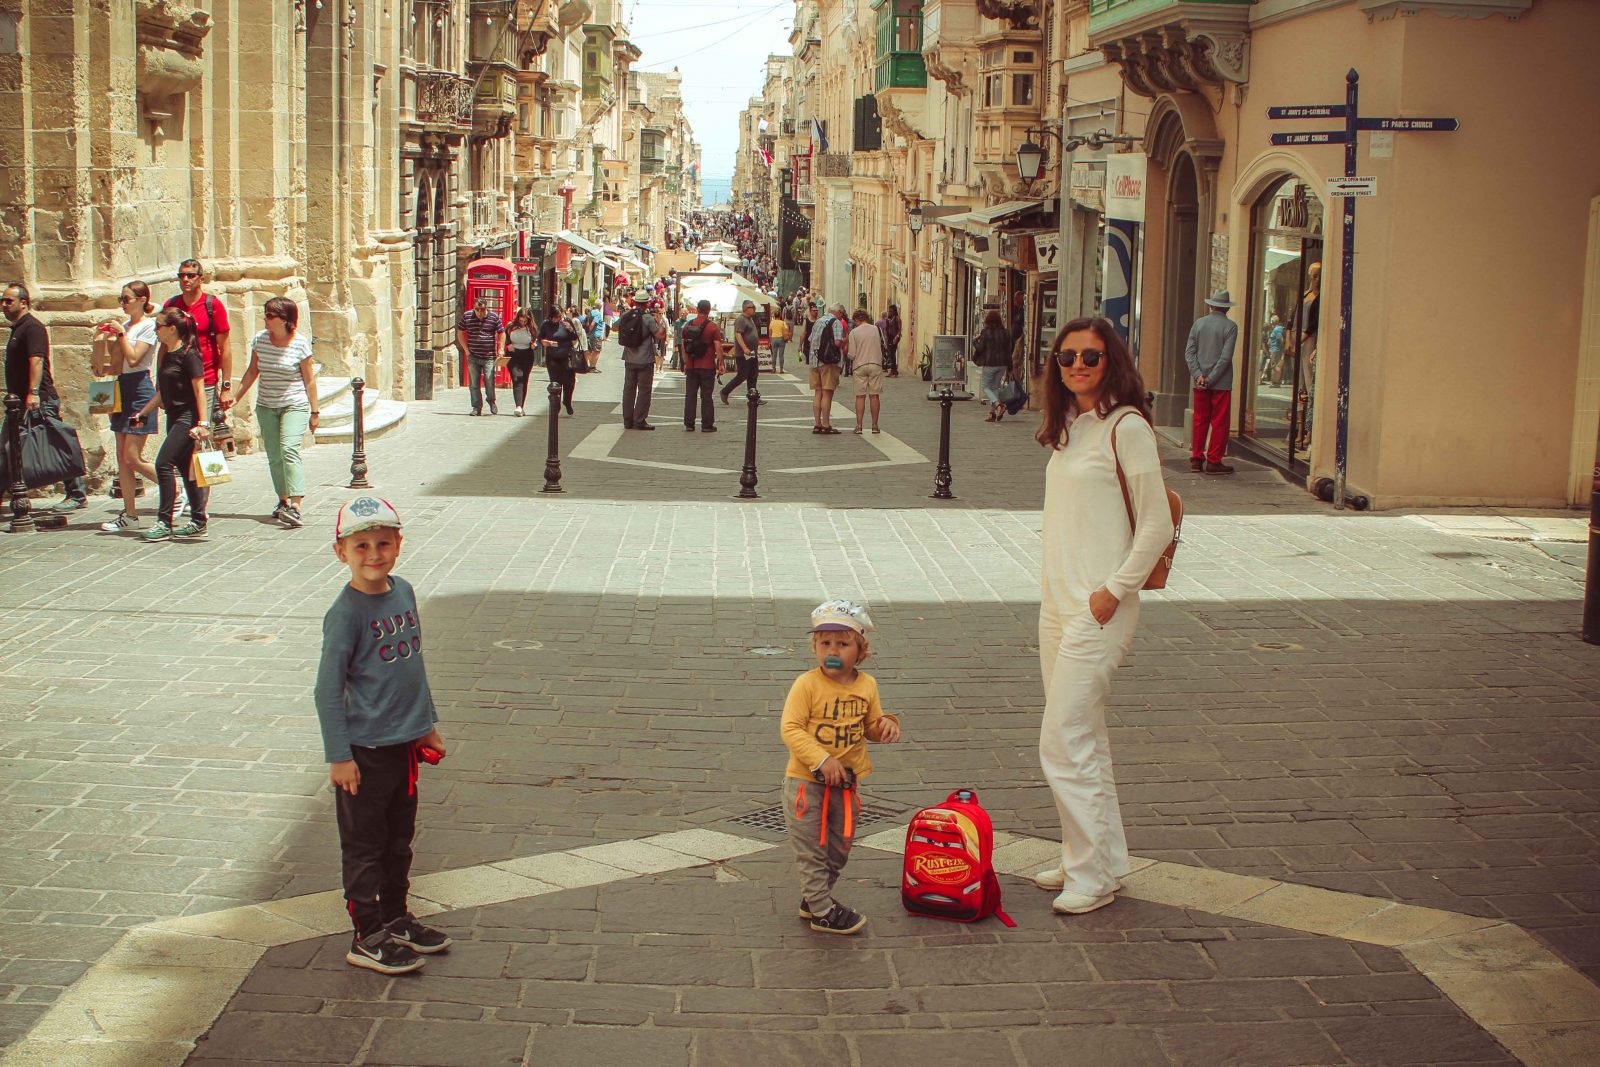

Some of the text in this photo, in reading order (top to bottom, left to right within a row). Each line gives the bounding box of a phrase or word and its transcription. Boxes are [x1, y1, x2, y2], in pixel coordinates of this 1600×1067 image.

[1381, 120, 1433, 129] ST PAUL'S CHURCH
[1286, 135, 1293, 143] ST
[1311, 134, 1329, 142] CHURCH
[371, 610, 416, 639] SUPE
[379, 636, 421, 663] COO
[815, 720, 864, 749] CHE
